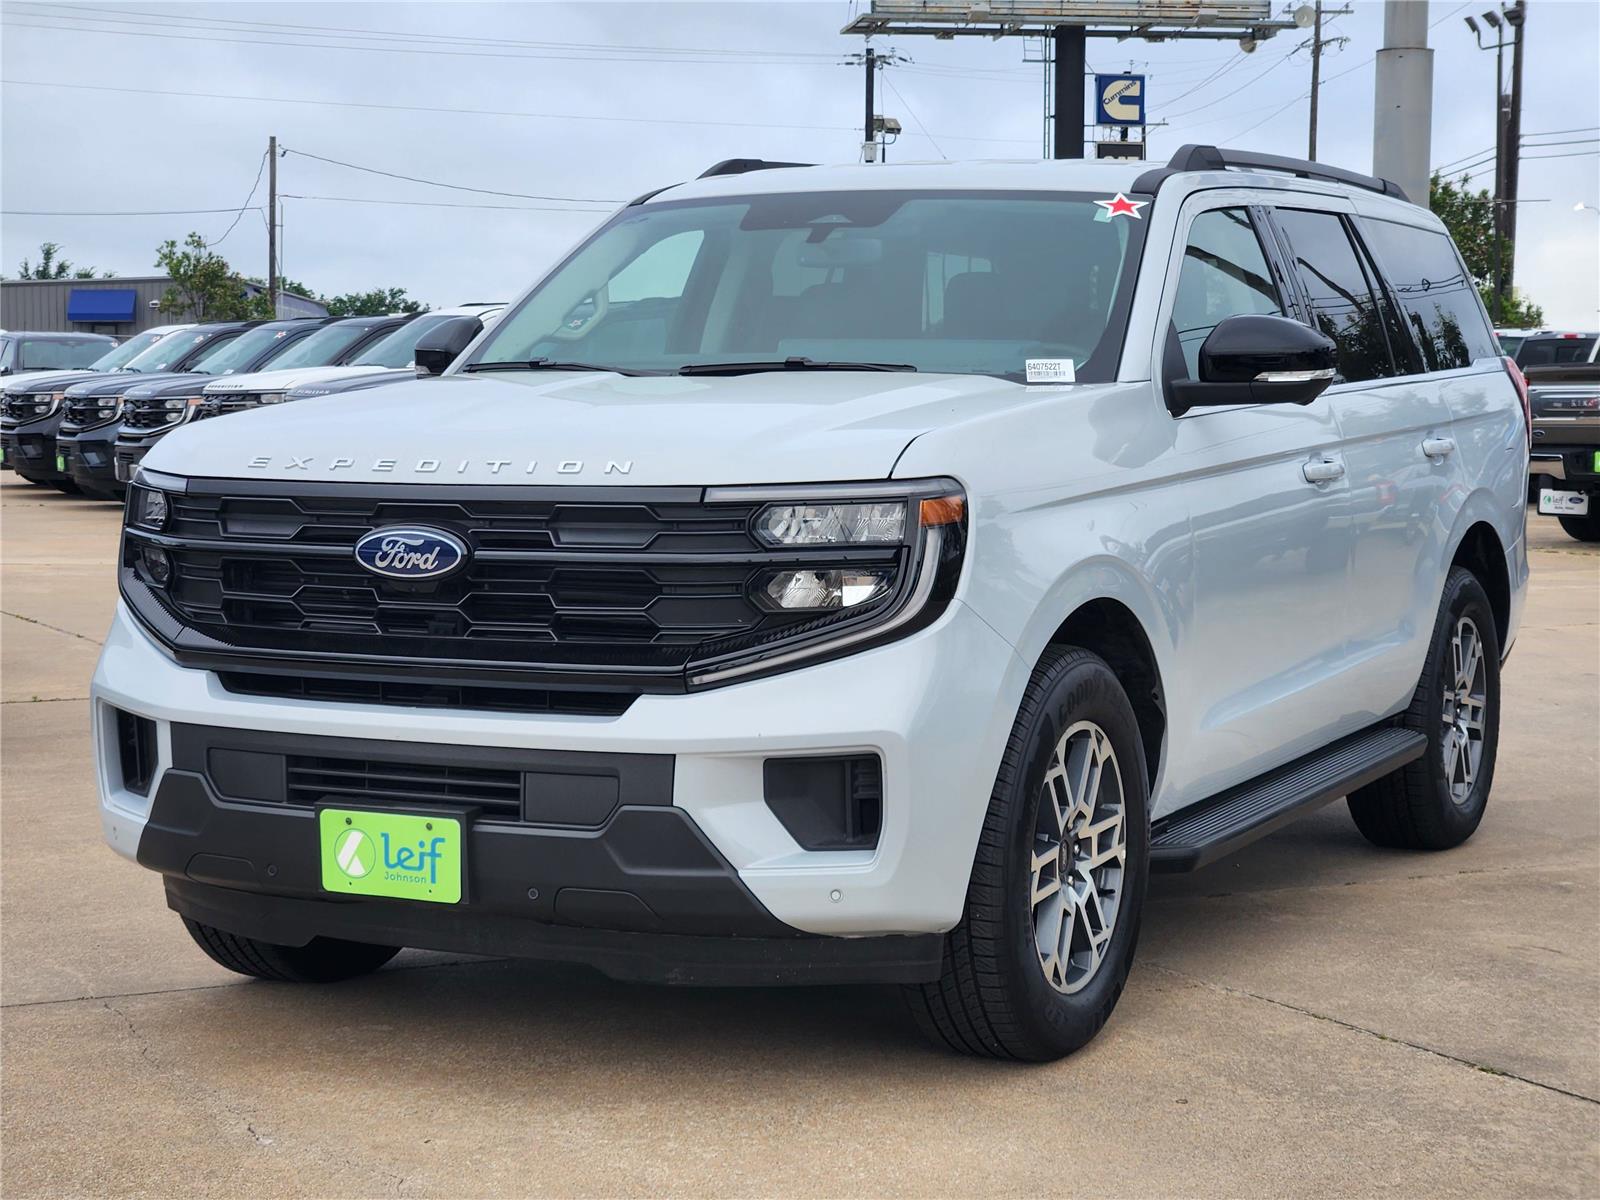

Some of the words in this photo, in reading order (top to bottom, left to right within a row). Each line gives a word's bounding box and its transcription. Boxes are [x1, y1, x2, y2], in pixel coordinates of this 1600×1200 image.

[1104, 80, 1137, 105] Cummins
[248, 456, 634, 475] EXPEDITION
[375, 537, 441, 569] Ford
[384, 872, 427, 884] Johnson
